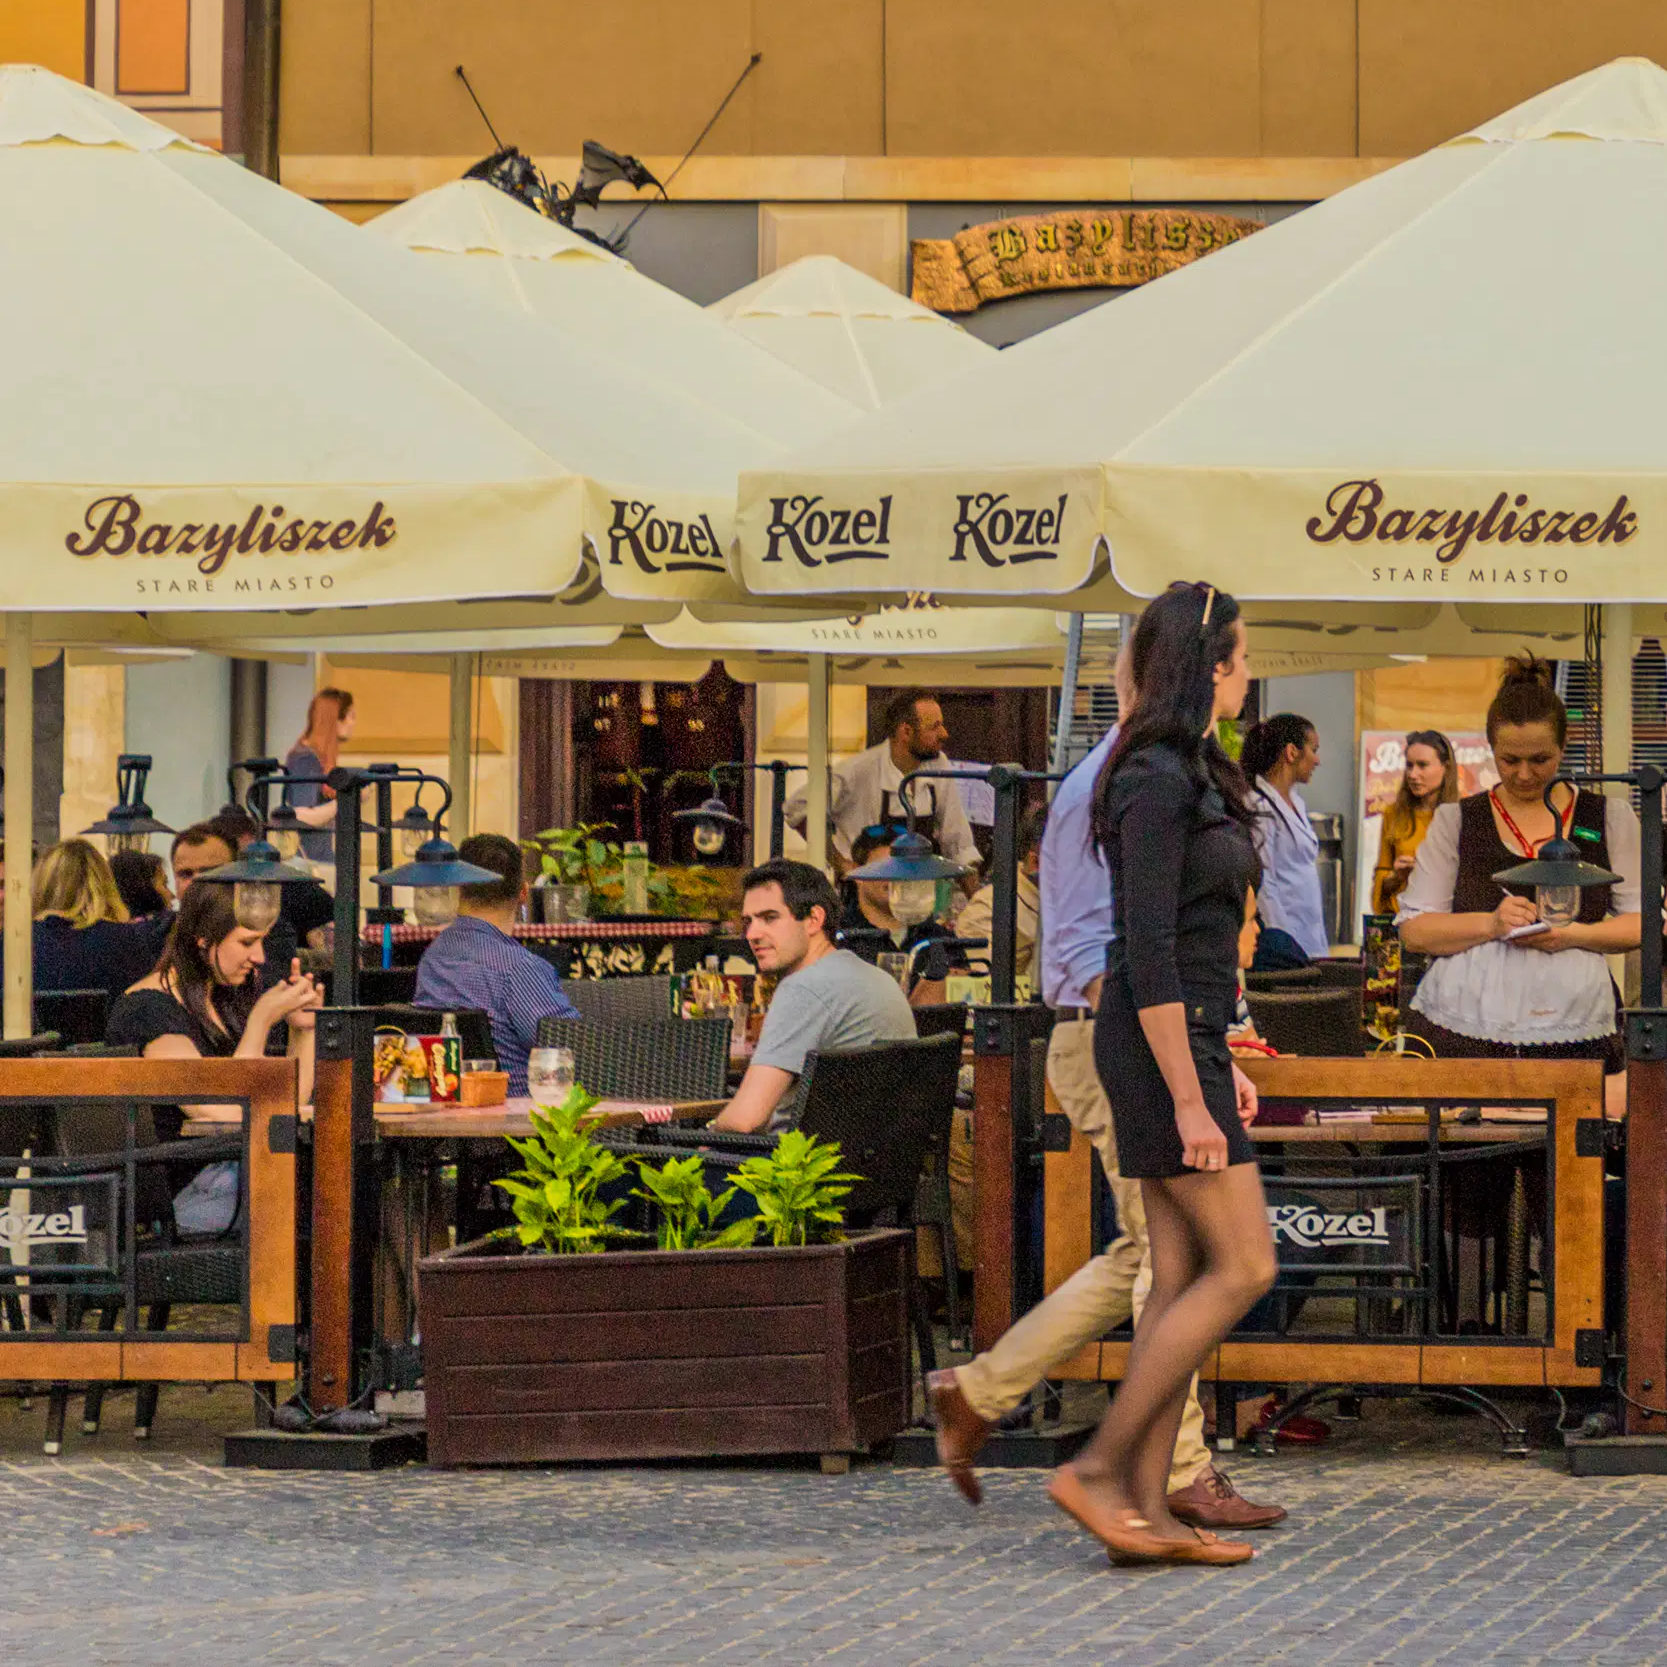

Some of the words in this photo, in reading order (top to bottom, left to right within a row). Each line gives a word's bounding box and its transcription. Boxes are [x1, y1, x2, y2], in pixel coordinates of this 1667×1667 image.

[66, 494, 398, 574] Bazyliszek
[608, 499, 726, 574] Kozel
[761, 493, 893, 568] Kozel
[948, 492, 1069, 568] Kozel
[1305, 478, 1639, 564] Bazyliszek
[136, 578, 216, 594] STARE
[234, 574, 335, 592] MIASTO
[1372, 566, 1449, 583] STARE
[1468, 567, 1569, 584] MIASTO
[873, 626, 938, 641] MIASTO
[0, 1204, 88, 1248] ozel
[1267, 1205, 1390, 1248] Kozel
